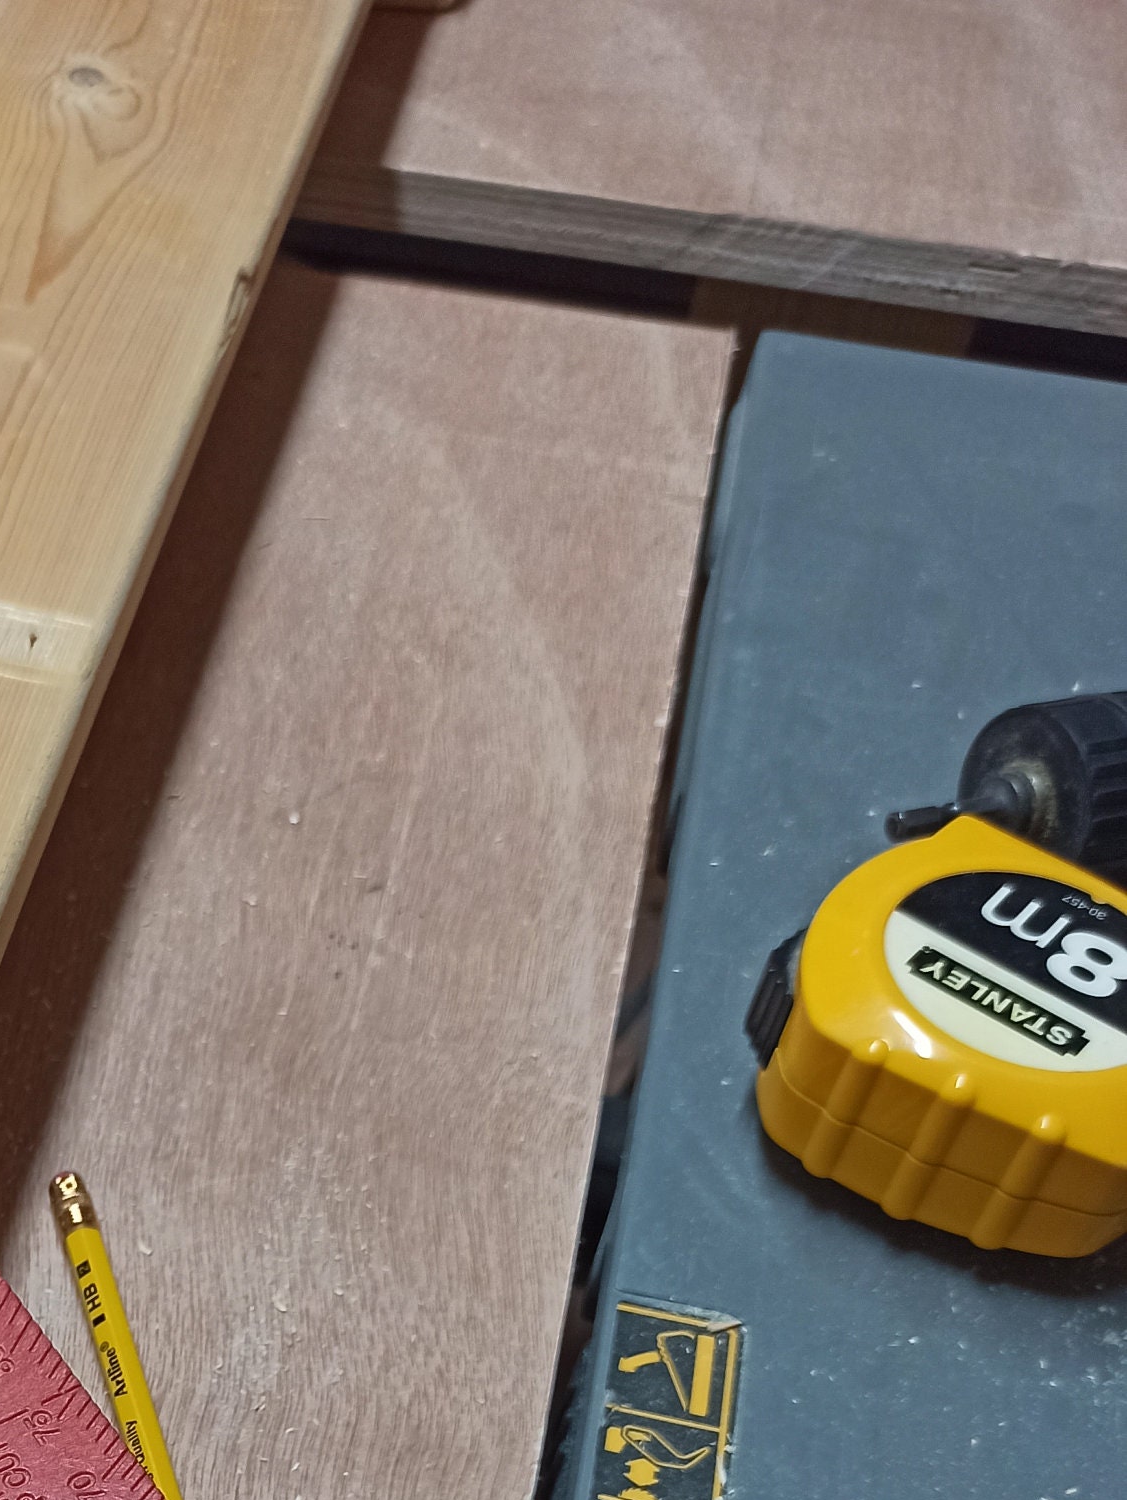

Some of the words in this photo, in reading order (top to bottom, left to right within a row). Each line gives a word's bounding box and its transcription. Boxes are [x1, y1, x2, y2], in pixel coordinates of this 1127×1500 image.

[981, 883, 1127, 998] 8m
[919, 961, 1073, 1046] STANLEY
[84, 1283, 101, 1313] HB
[24, 1409, 62, 1446] 75
